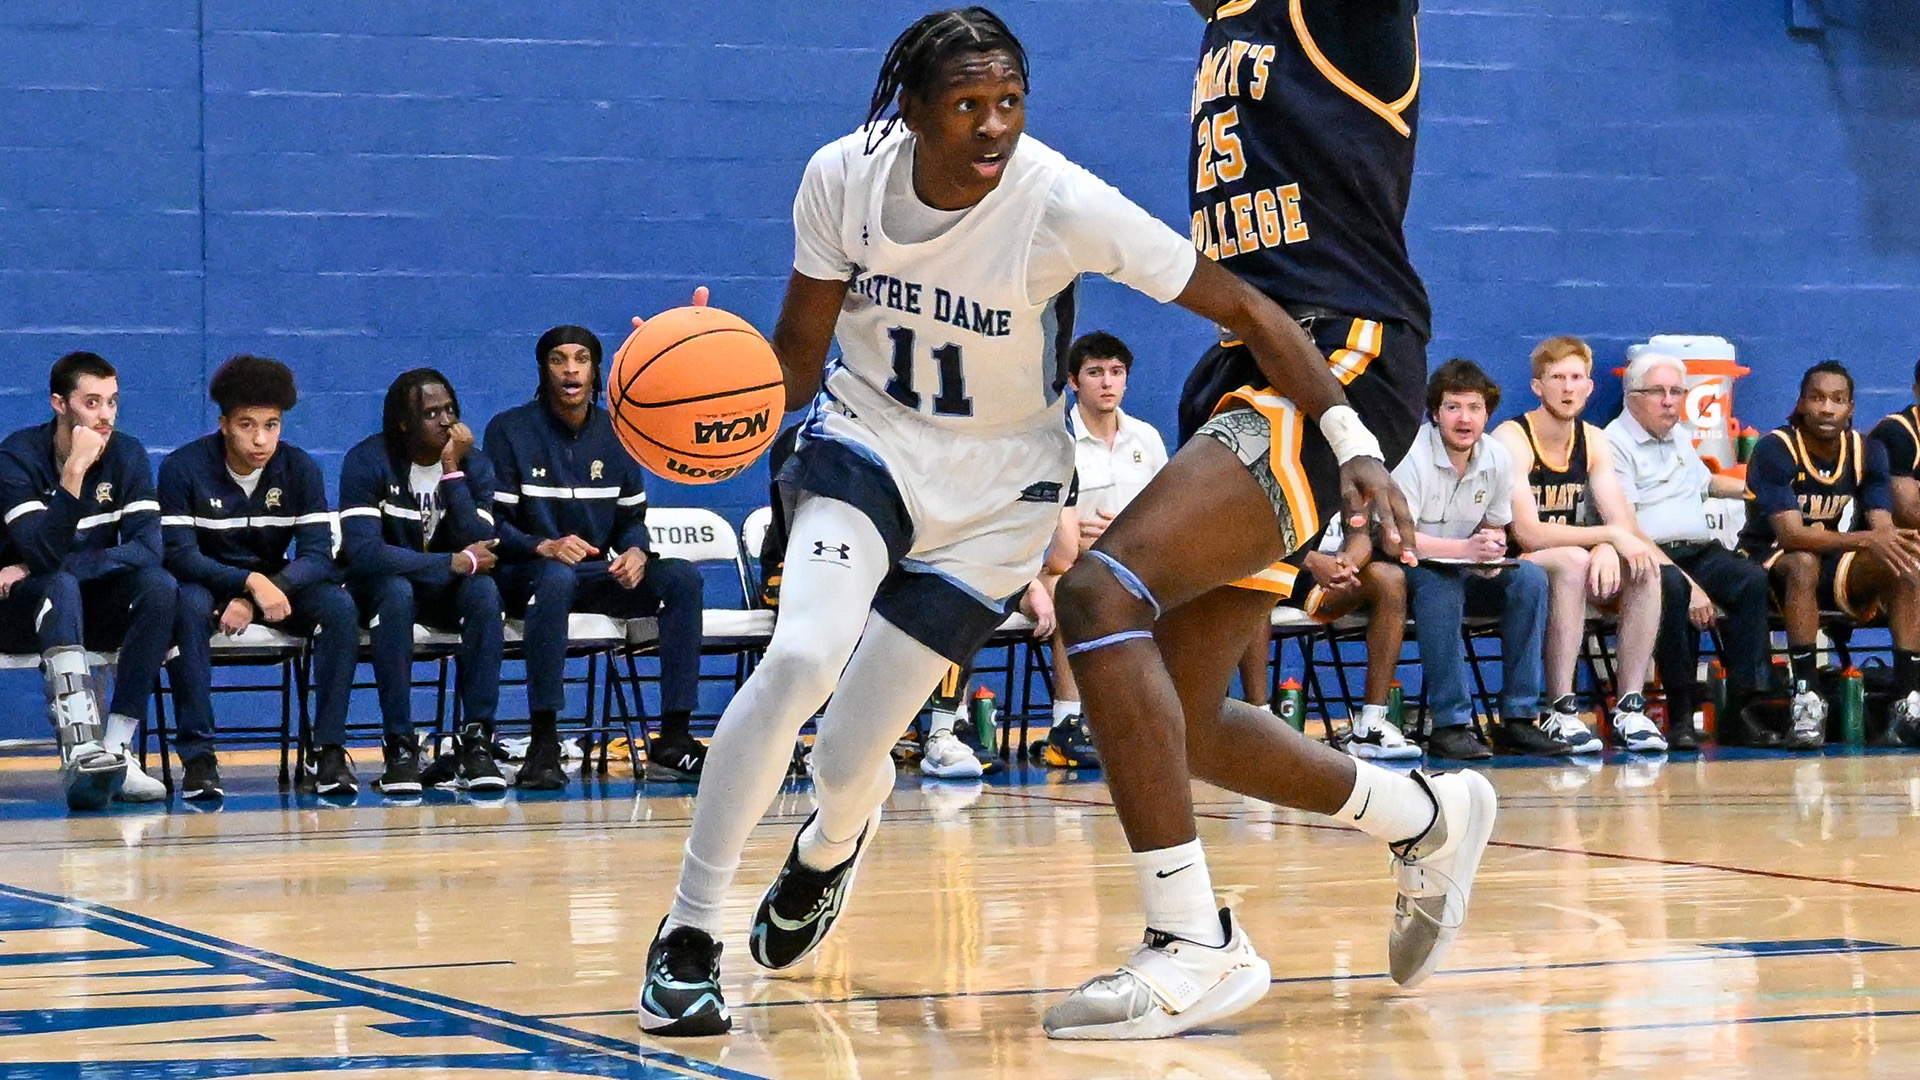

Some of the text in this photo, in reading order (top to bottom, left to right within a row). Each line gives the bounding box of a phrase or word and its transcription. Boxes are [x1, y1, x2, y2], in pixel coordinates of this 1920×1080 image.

[1196, 105, 1247, 193] 25
[1191, 183, 1310, 261] OLLEGE
[934, 287, 1012, 337] DAME
[884, 324, 974, 417] 11
[694, 408, 770, 444] NCAA
[1685, 384, 1721, 428] G
[650, 526, 715, 544] TORS
